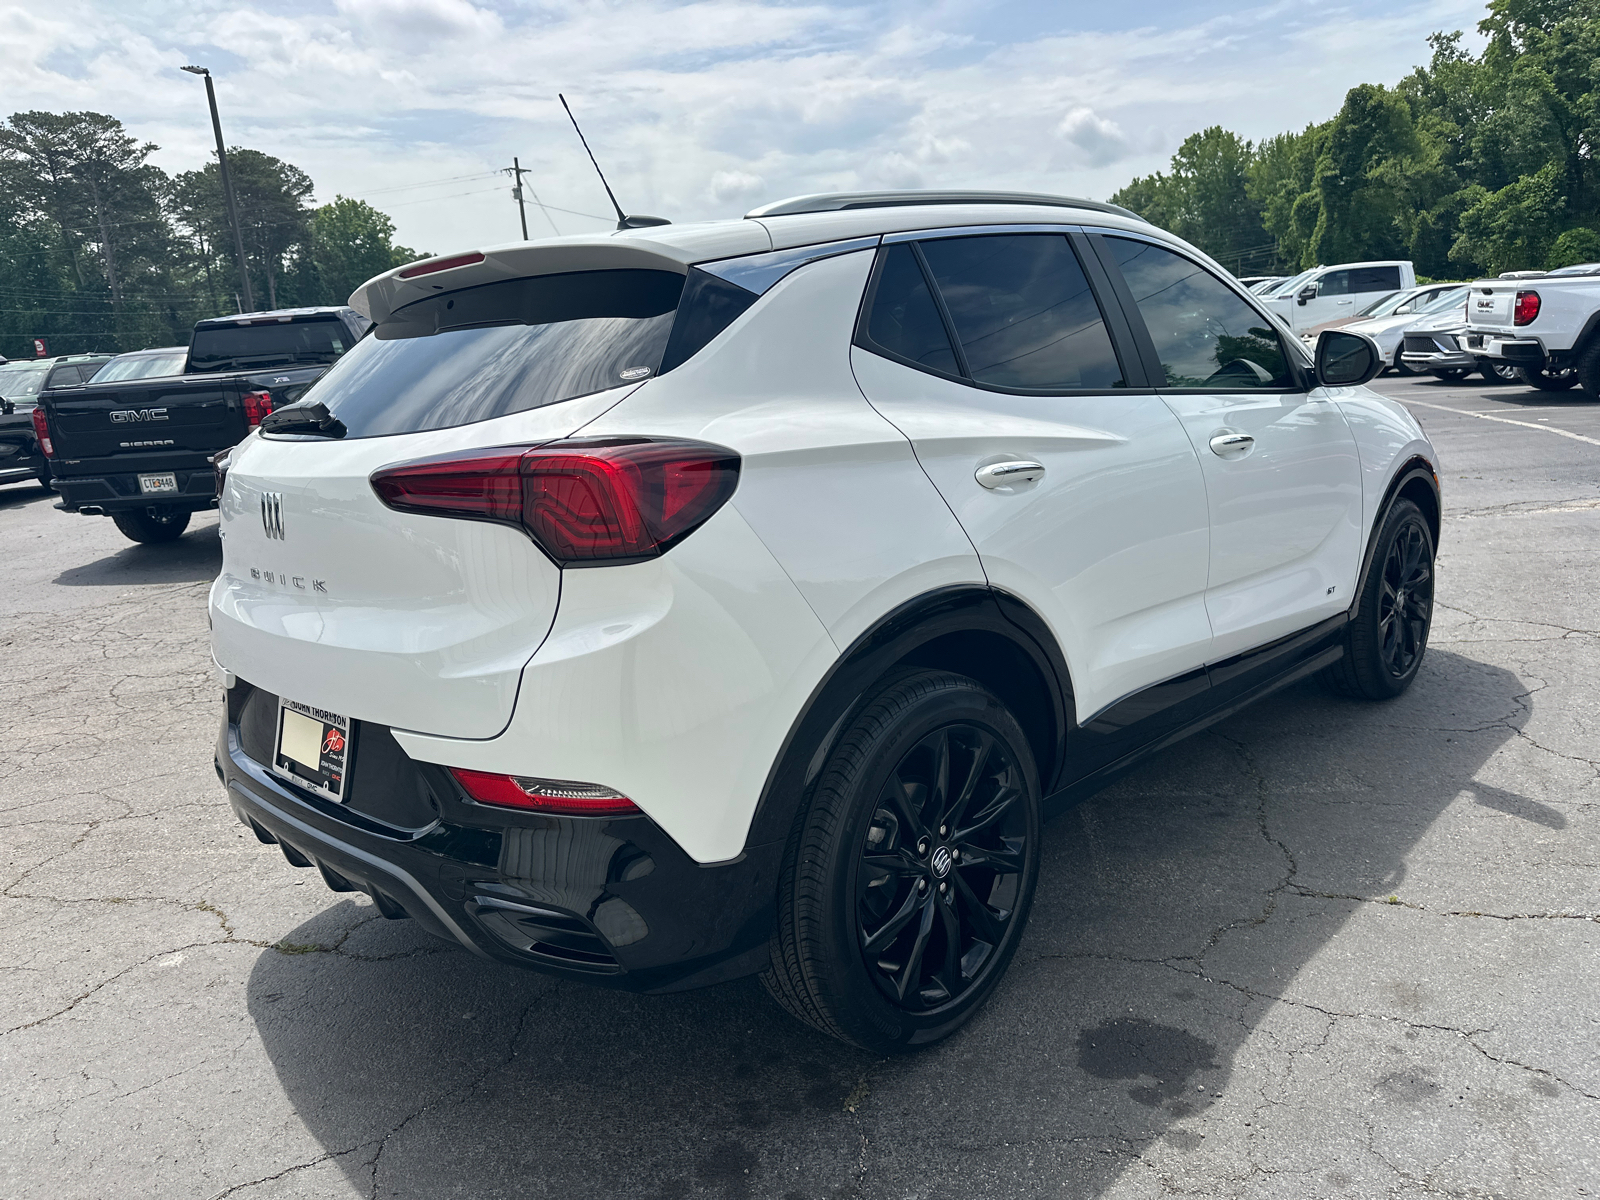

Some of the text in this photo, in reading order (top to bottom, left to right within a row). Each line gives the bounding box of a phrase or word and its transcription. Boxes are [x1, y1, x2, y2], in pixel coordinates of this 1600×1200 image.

[109, 408, 169, 423] GMC
[250, 567, 327, 593] BUICK
[295, 702, 347, 728] JOHN THORNTON
